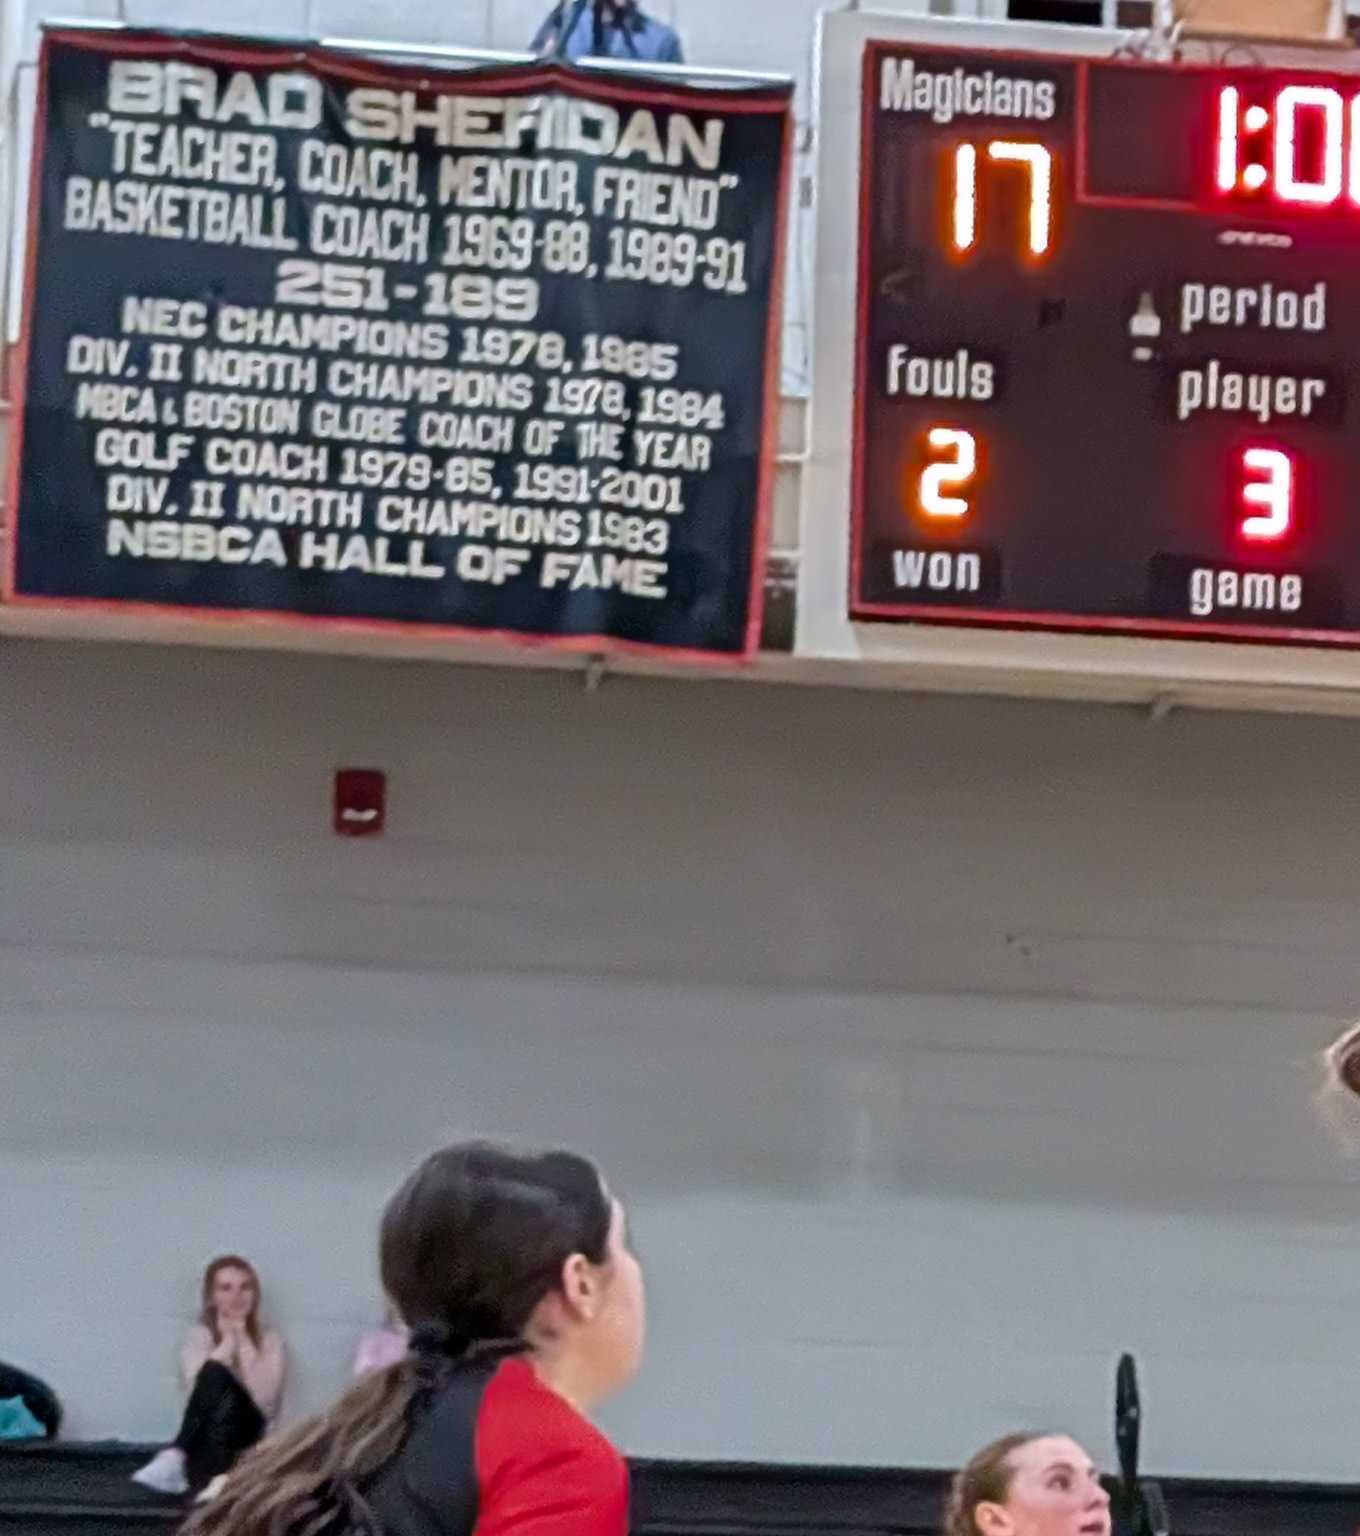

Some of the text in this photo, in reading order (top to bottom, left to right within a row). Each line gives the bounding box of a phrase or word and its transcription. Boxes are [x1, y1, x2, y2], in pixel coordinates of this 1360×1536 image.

[108, 60, 725, 170] BRAD SHERIDAN
[880, 57, 1055, 123] Magicians
[299, 139, 427, 208] COACH,
[440, 153, 585, 217] MENTOR,
[951, 140, 1051, 255] 17
[63, 175, 747, 294] BASKETBALL COACH 1969-88, 1989-91
[274, 258, 540, 322] 251-189
[1181, 282, 1327, 333] period
[120, 296, 680, 381] NEC CHAMPIONS 1978, 1985
[887, 345, 994, 400] fouls
[66, 334, 726, 430] DIV. II NORTH CHAMPIONS 1978, 1984
[1178, 362, 1326, 422] player
[75, 381, 157, 424] MBCA
[183, 390, 301, 436] BOSTON
[311, 401, 407, 445] GLOBE
[417, 410, 515, 453] COACH
[521, 419, 566, 457] OF
[575, 421, 625, 461] THE
[632, 429, 712, 472] YEAR
[94, 428, 685, 515] GOLF COACH 1979-85, 1991-2001
[917, 428, 976, 517] 2
[1241, 449, 1291, 540] 3
[106, 473, 670, 556] DIV. II NORTH CHAMPIONS 1983
[105, 518, 669, 599] NSBCA HALL OF FAME
[893, 550, 980, 591] won
[1189, 568, 1302, 617] game
